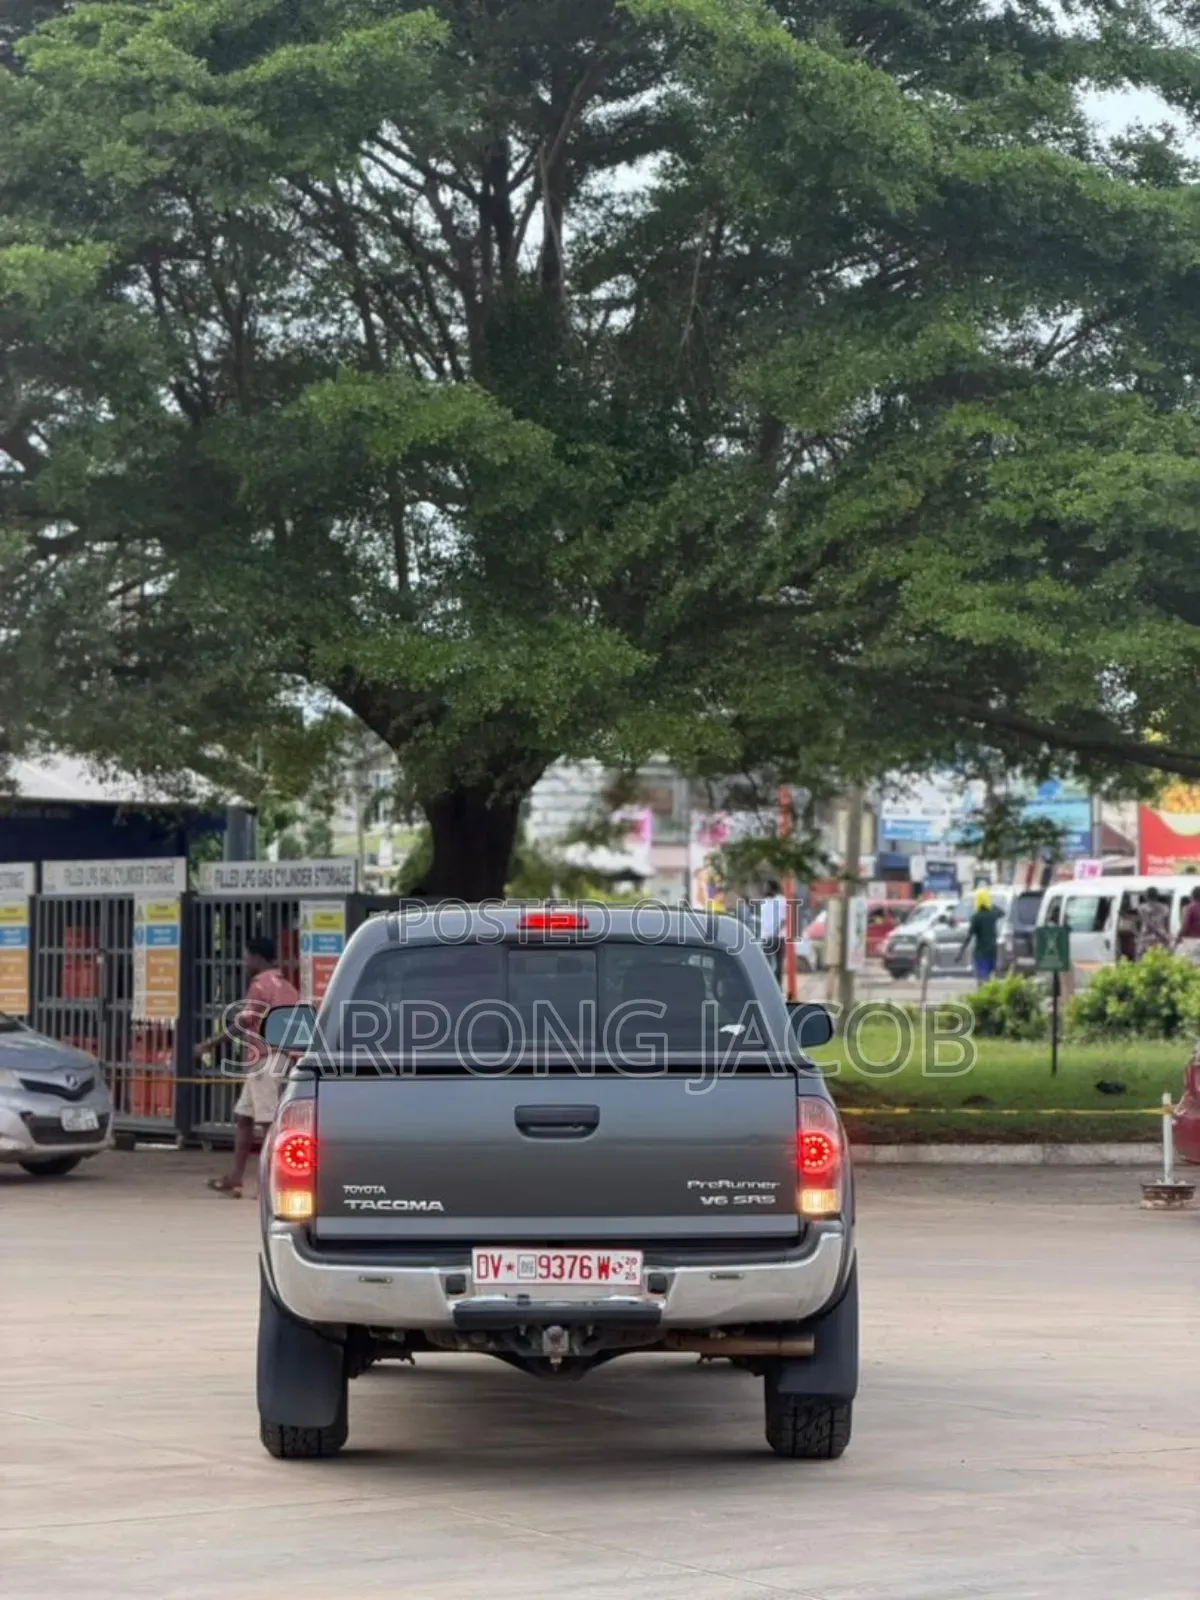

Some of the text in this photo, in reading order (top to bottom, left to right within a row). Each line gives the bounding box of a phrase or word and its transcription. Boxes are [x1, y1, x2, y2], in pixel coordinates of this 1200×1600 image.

[343, 1184, 386, 1194] TOYOTA
[343, 1199, 445, 1211] TACOMA
[700, 1195, 728, 1205] V6
[476, 1254, 502, 1280] DV
[538, 1254, 593, 1280] 9376
[597, 1255, 611, 1280] W
